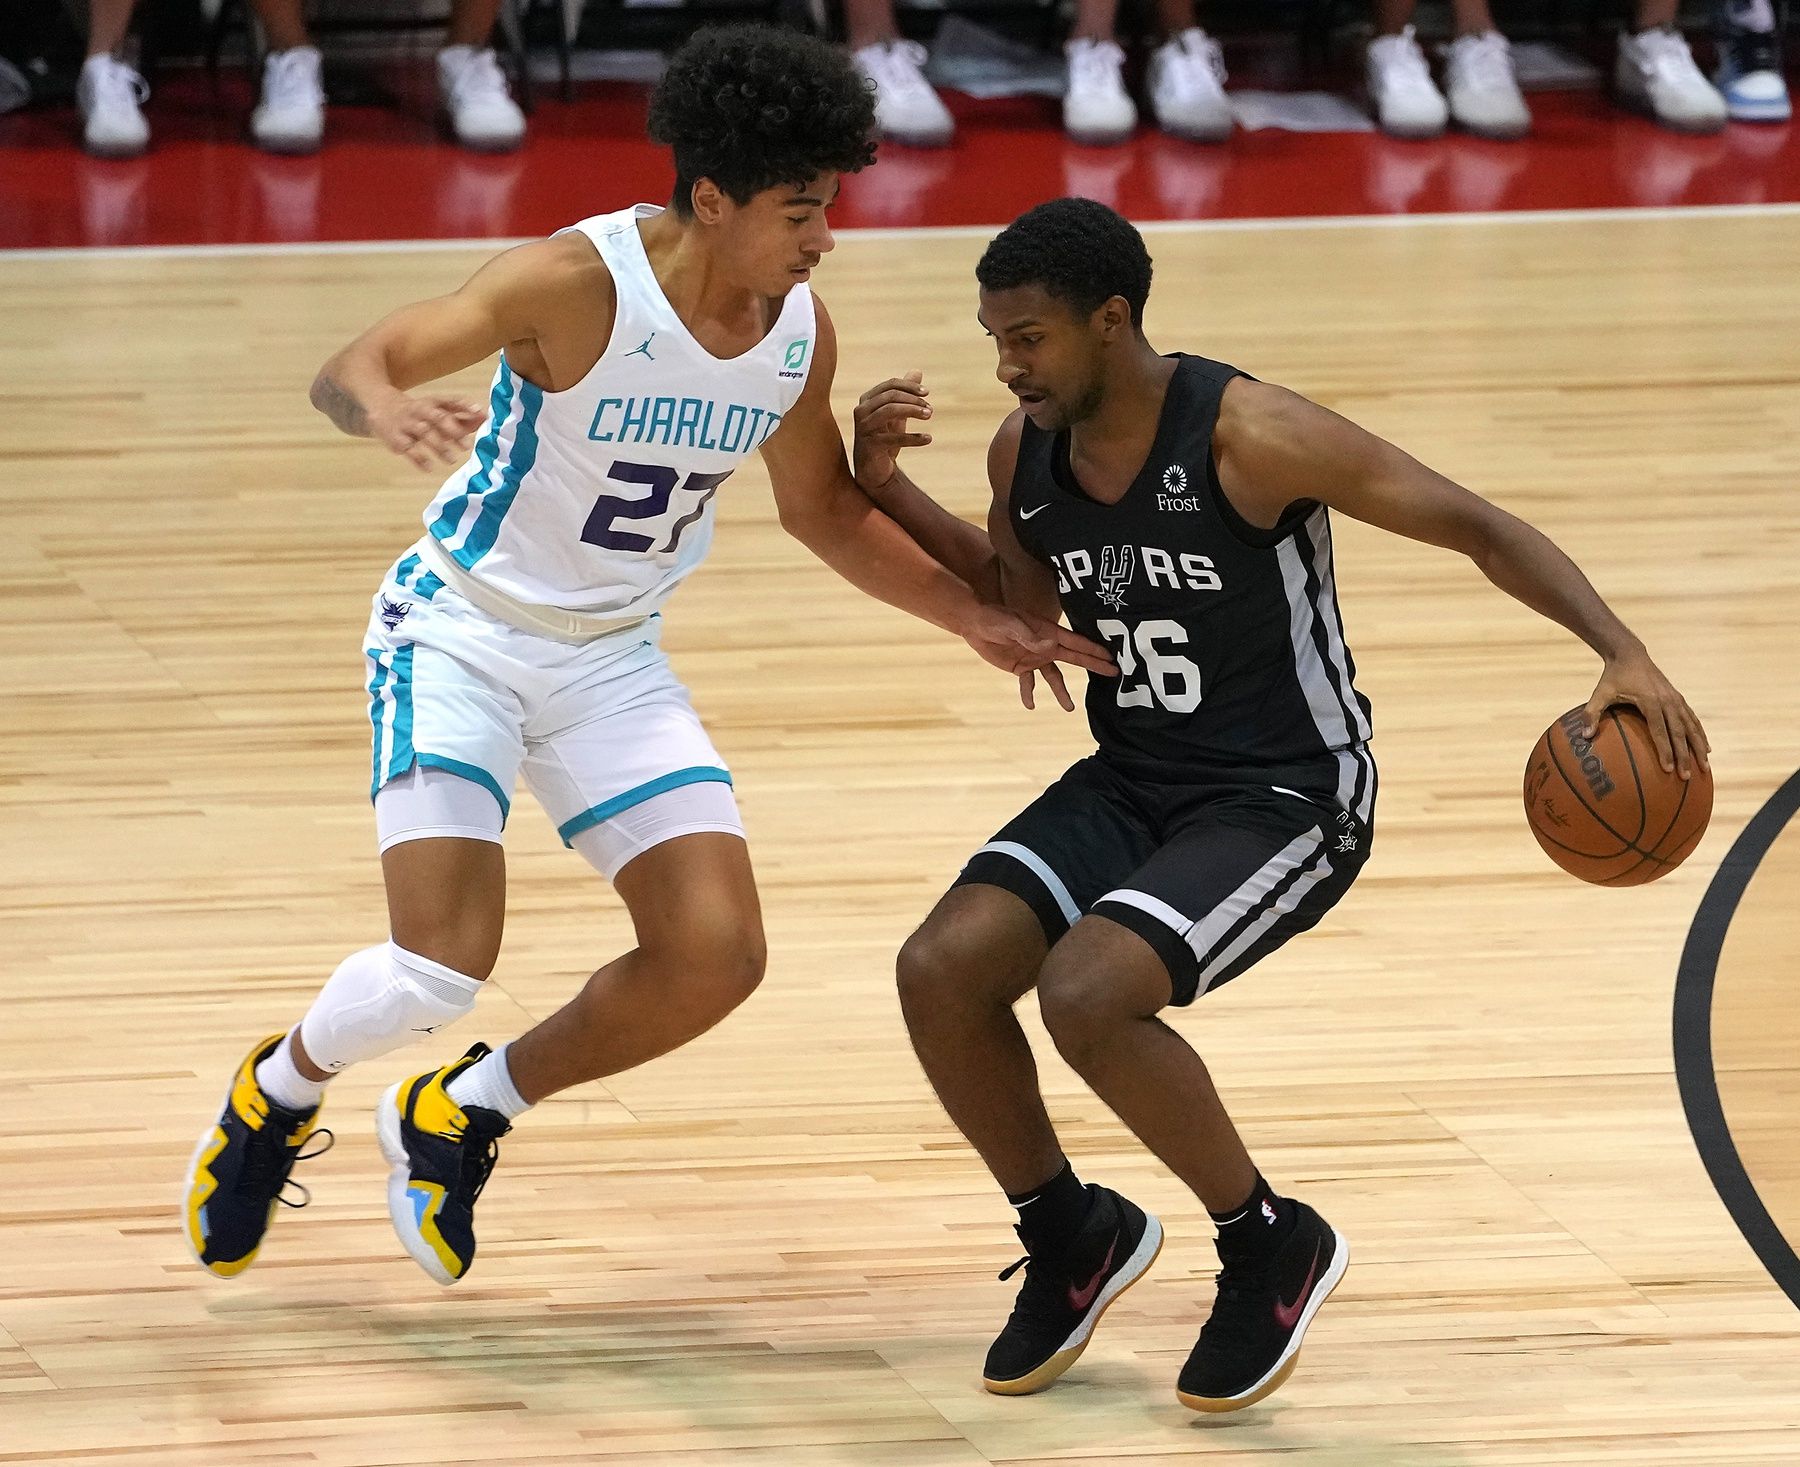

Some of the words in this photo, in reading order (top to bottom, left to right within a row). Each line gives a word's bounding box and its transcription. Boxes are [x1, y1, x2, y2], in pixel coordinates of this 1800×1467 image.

[587, 397, 782, 454] CHARLOTT
[579, 460, 736, 554] 27
[1155, 493, 1201, 512] Frost
[1096, 619, 1202, 714] 26
